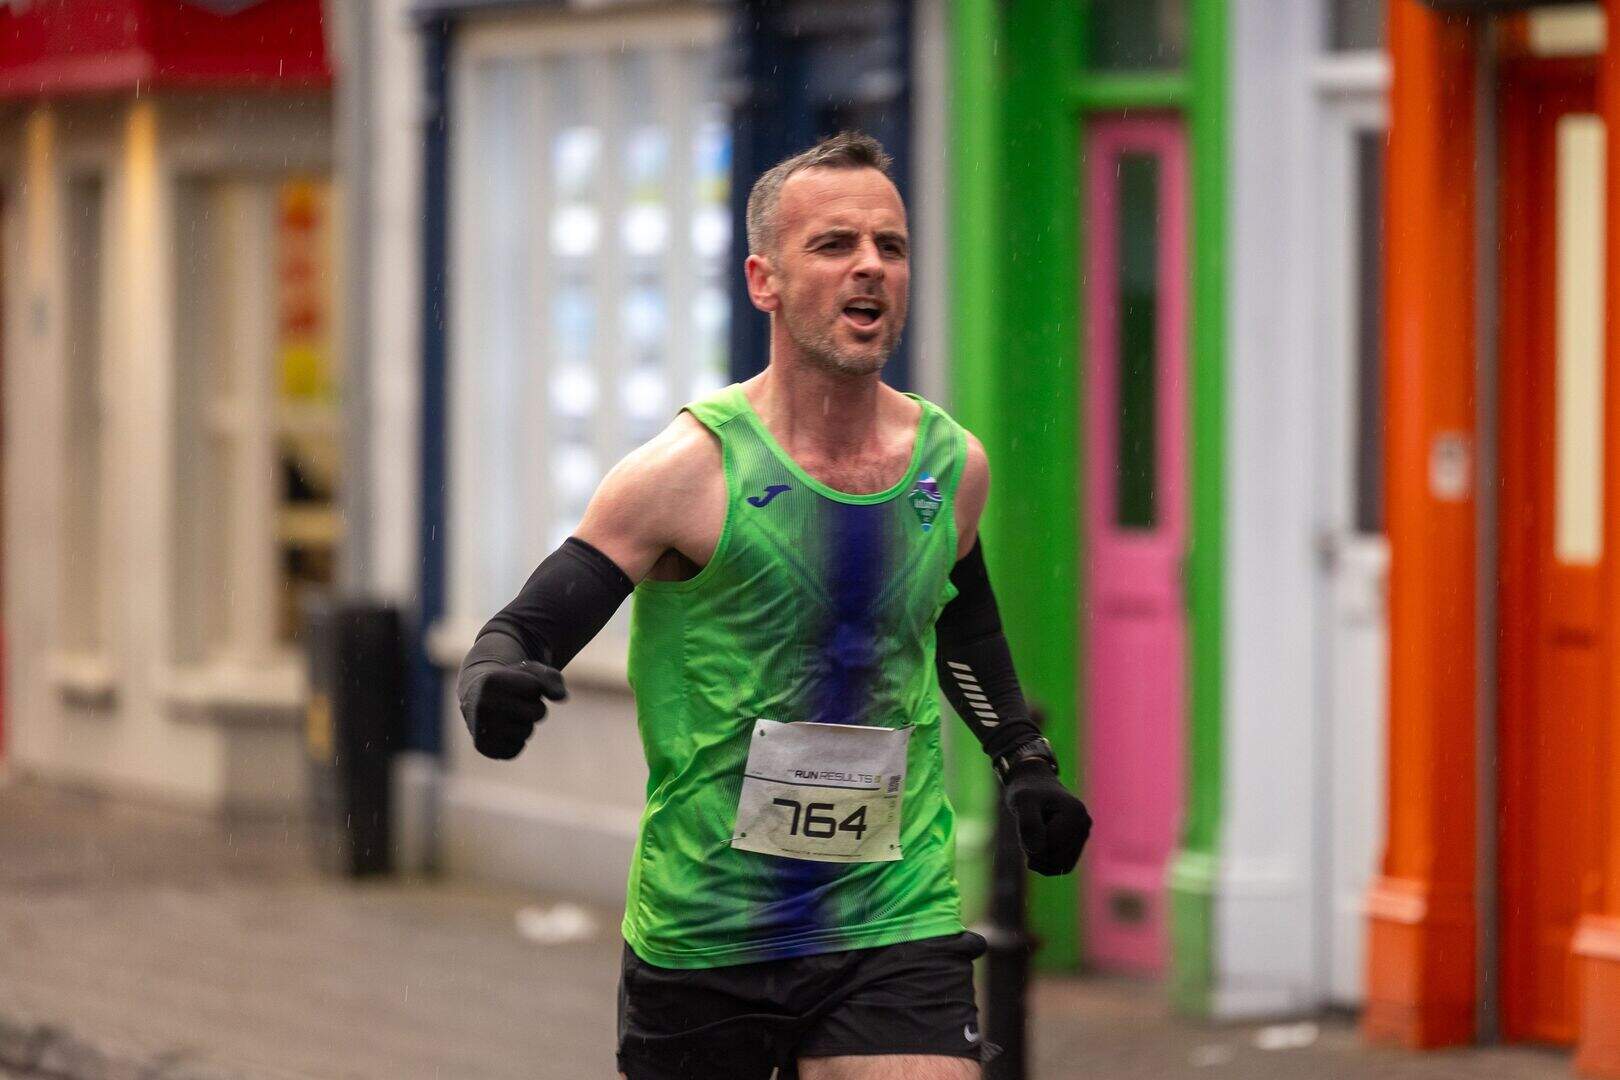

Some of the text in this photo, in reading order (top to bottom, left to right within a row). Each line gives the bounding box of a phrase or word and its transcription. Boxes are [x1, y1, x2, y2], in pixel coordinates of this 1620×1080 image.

[794, 769, 873, 784] RUN RESULTS
[773, 797, 867, 840] 764
